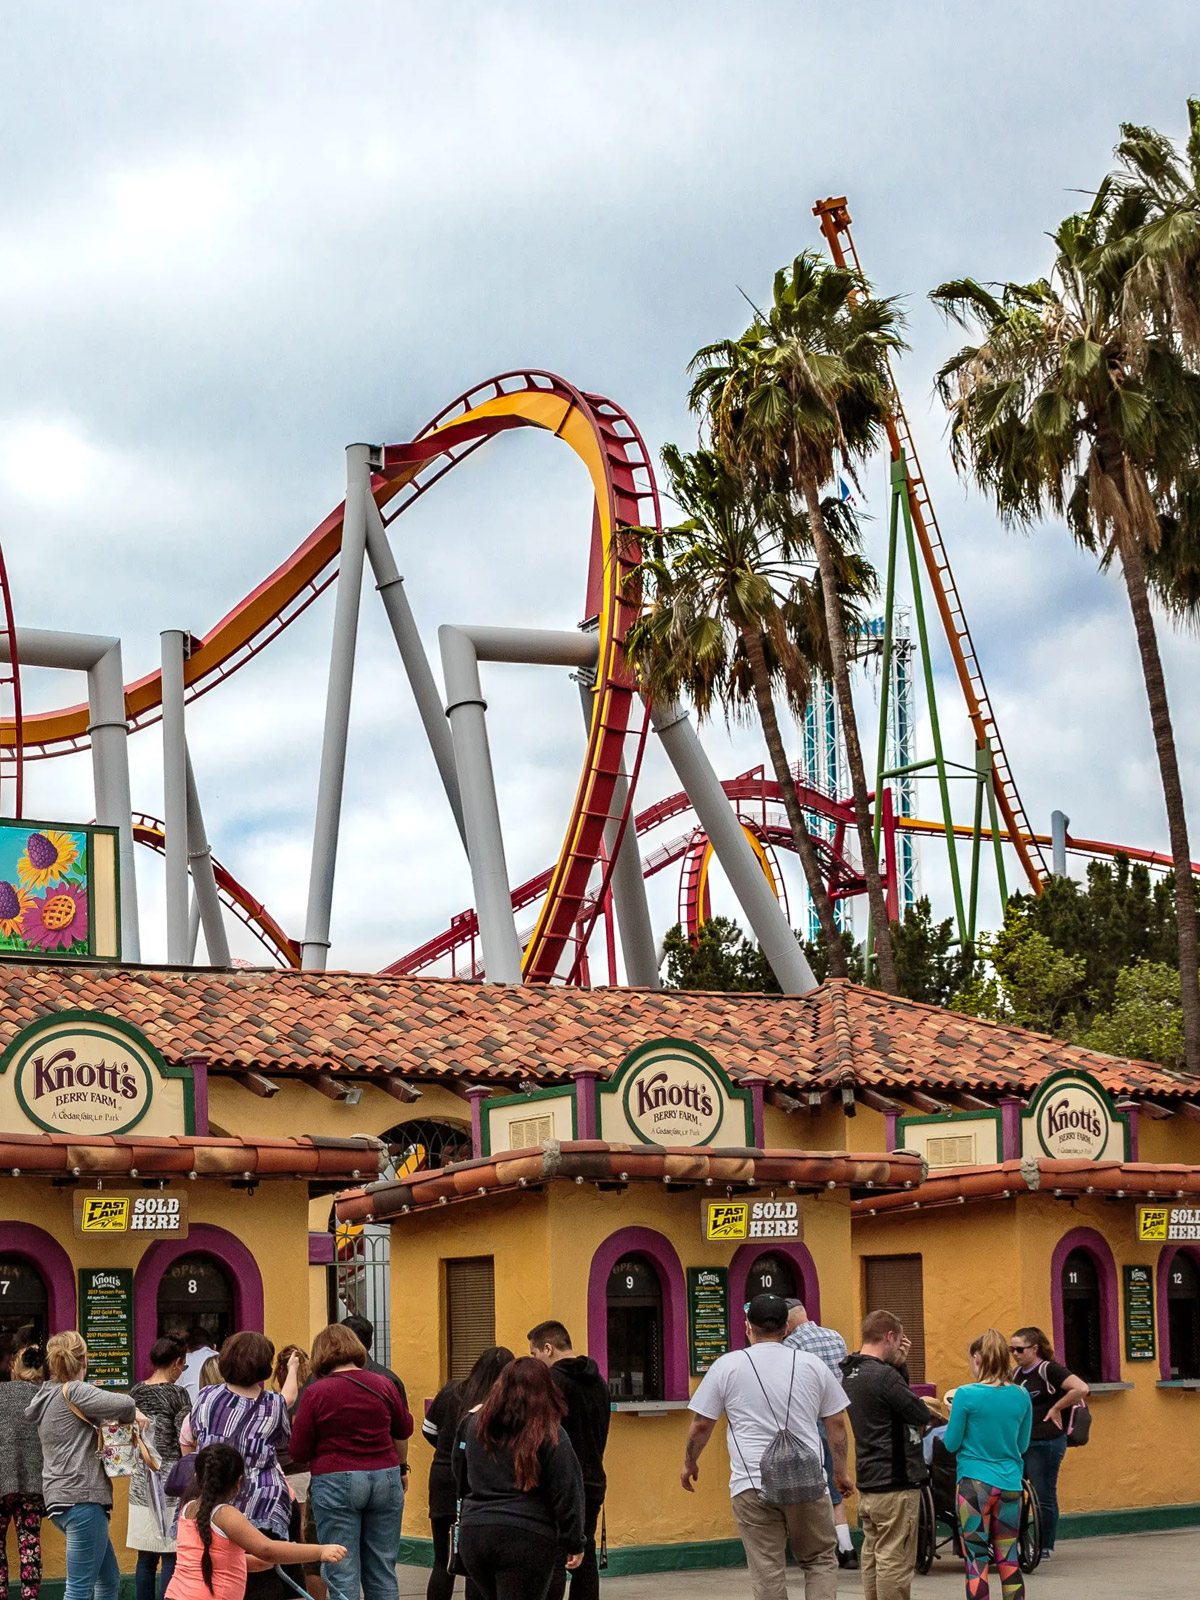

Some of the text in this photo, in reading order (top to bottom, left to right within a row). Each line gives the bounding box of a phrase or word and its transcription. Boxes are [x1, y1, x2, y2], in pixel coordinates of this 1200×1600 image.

[31, 1048, 138, 1100] Knott's
[56, 1092, 116, 1108] BERRY FARM
[635, 1071, 712, 1118] Knott's
[105, 1113, 119, 1121] Park
[654, 1110, 698, 1124] BERRY FARM
[1046, 1098, 1101, 1138] Knott's
[90, 1202, 125, 1211] FAST
[134, 1198, 179, 1213] SOLD
[752, 1202, 797, 1219] SOLD
[87, 1209, 124, 1222] LANE
[714, 1208, 744, 1218] FAST
[1144, 1213, 1165, 1221] FAST
[131, 1214, 180, 1230] HERE
[712, 1215, 743, 1230] LANE
[749, 1220, 798, 1237] HERE
[1143, 1220, 1164, 1231] LANE
[92, 1272, 121, 1288] Knott's
[626, 1276, 634, 1289] 9
[698, 1271, 719, 1284] Knott's
[760, 1275, 772, 1287] 10
[1069, 1272, 1077, 1283] 11
[1173, 1273, 1182, 1284] 12
[0, 1281, 10, 1295] 7
[188, 1279, 197, 1294] 8
